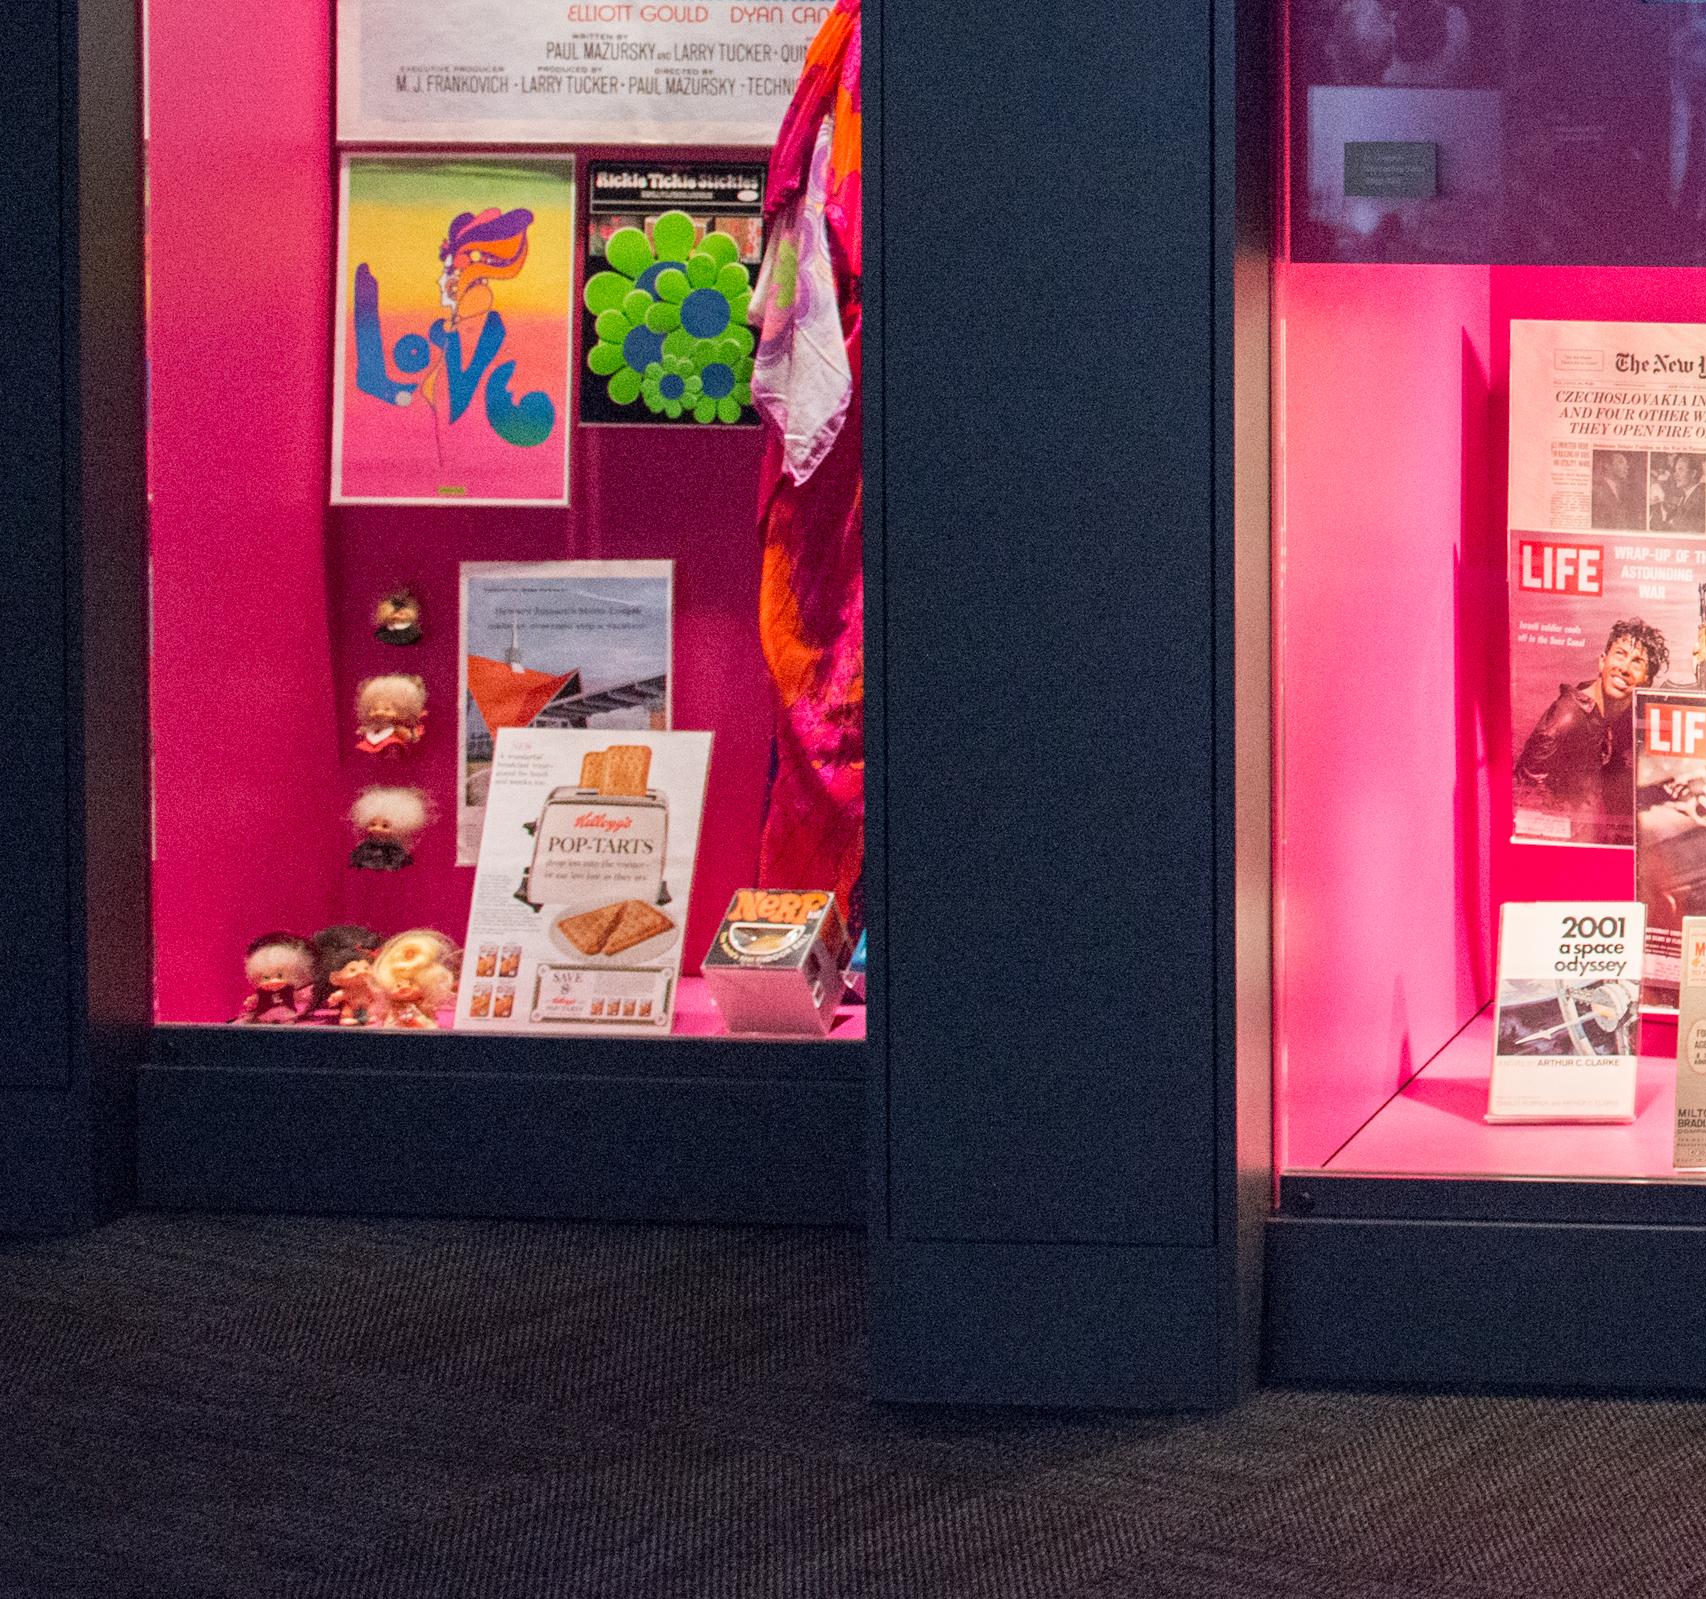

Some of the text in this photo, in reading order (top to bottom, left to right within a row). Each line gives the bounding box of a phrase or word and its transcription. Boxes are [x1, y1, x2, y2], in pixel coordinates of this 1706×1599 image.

[1616, 353, 1649, 373] The
[1653, 354, 1694, 374] New
[1556, 390, 1687, 407] CZECHOSLOVAKIA
[1559, 407, 1594, 420] AND
[1596, 407, 1635, 421] FOUR
[1638, 409, 1688, 422] OTHER
[1570, 422, 1609, 435] THEY
[1613, 424, 1659, 437] OPEN
[1661, 425, 1691, 438] FIRE
[1614, 546, 1671, 562] WRAP-UP
[1676, 549, 1690, 563] OF
[1522, 545, 1600, 592] LIFE
[1621, 566, 1693, 582] ASTOUNDING
[1640, 585, 1666, 599] WAR
[548, 837, 654, 854] POP-TARTS
[1562, 917, 1626, 939] 2001
[1559, 942, 1624, 959] a space
[1554, 957, 1627, 976] odyssey
[1537, 1059, 1572, 1067] ARTHUR
[1574, 1059, 1582, 1067] C.
